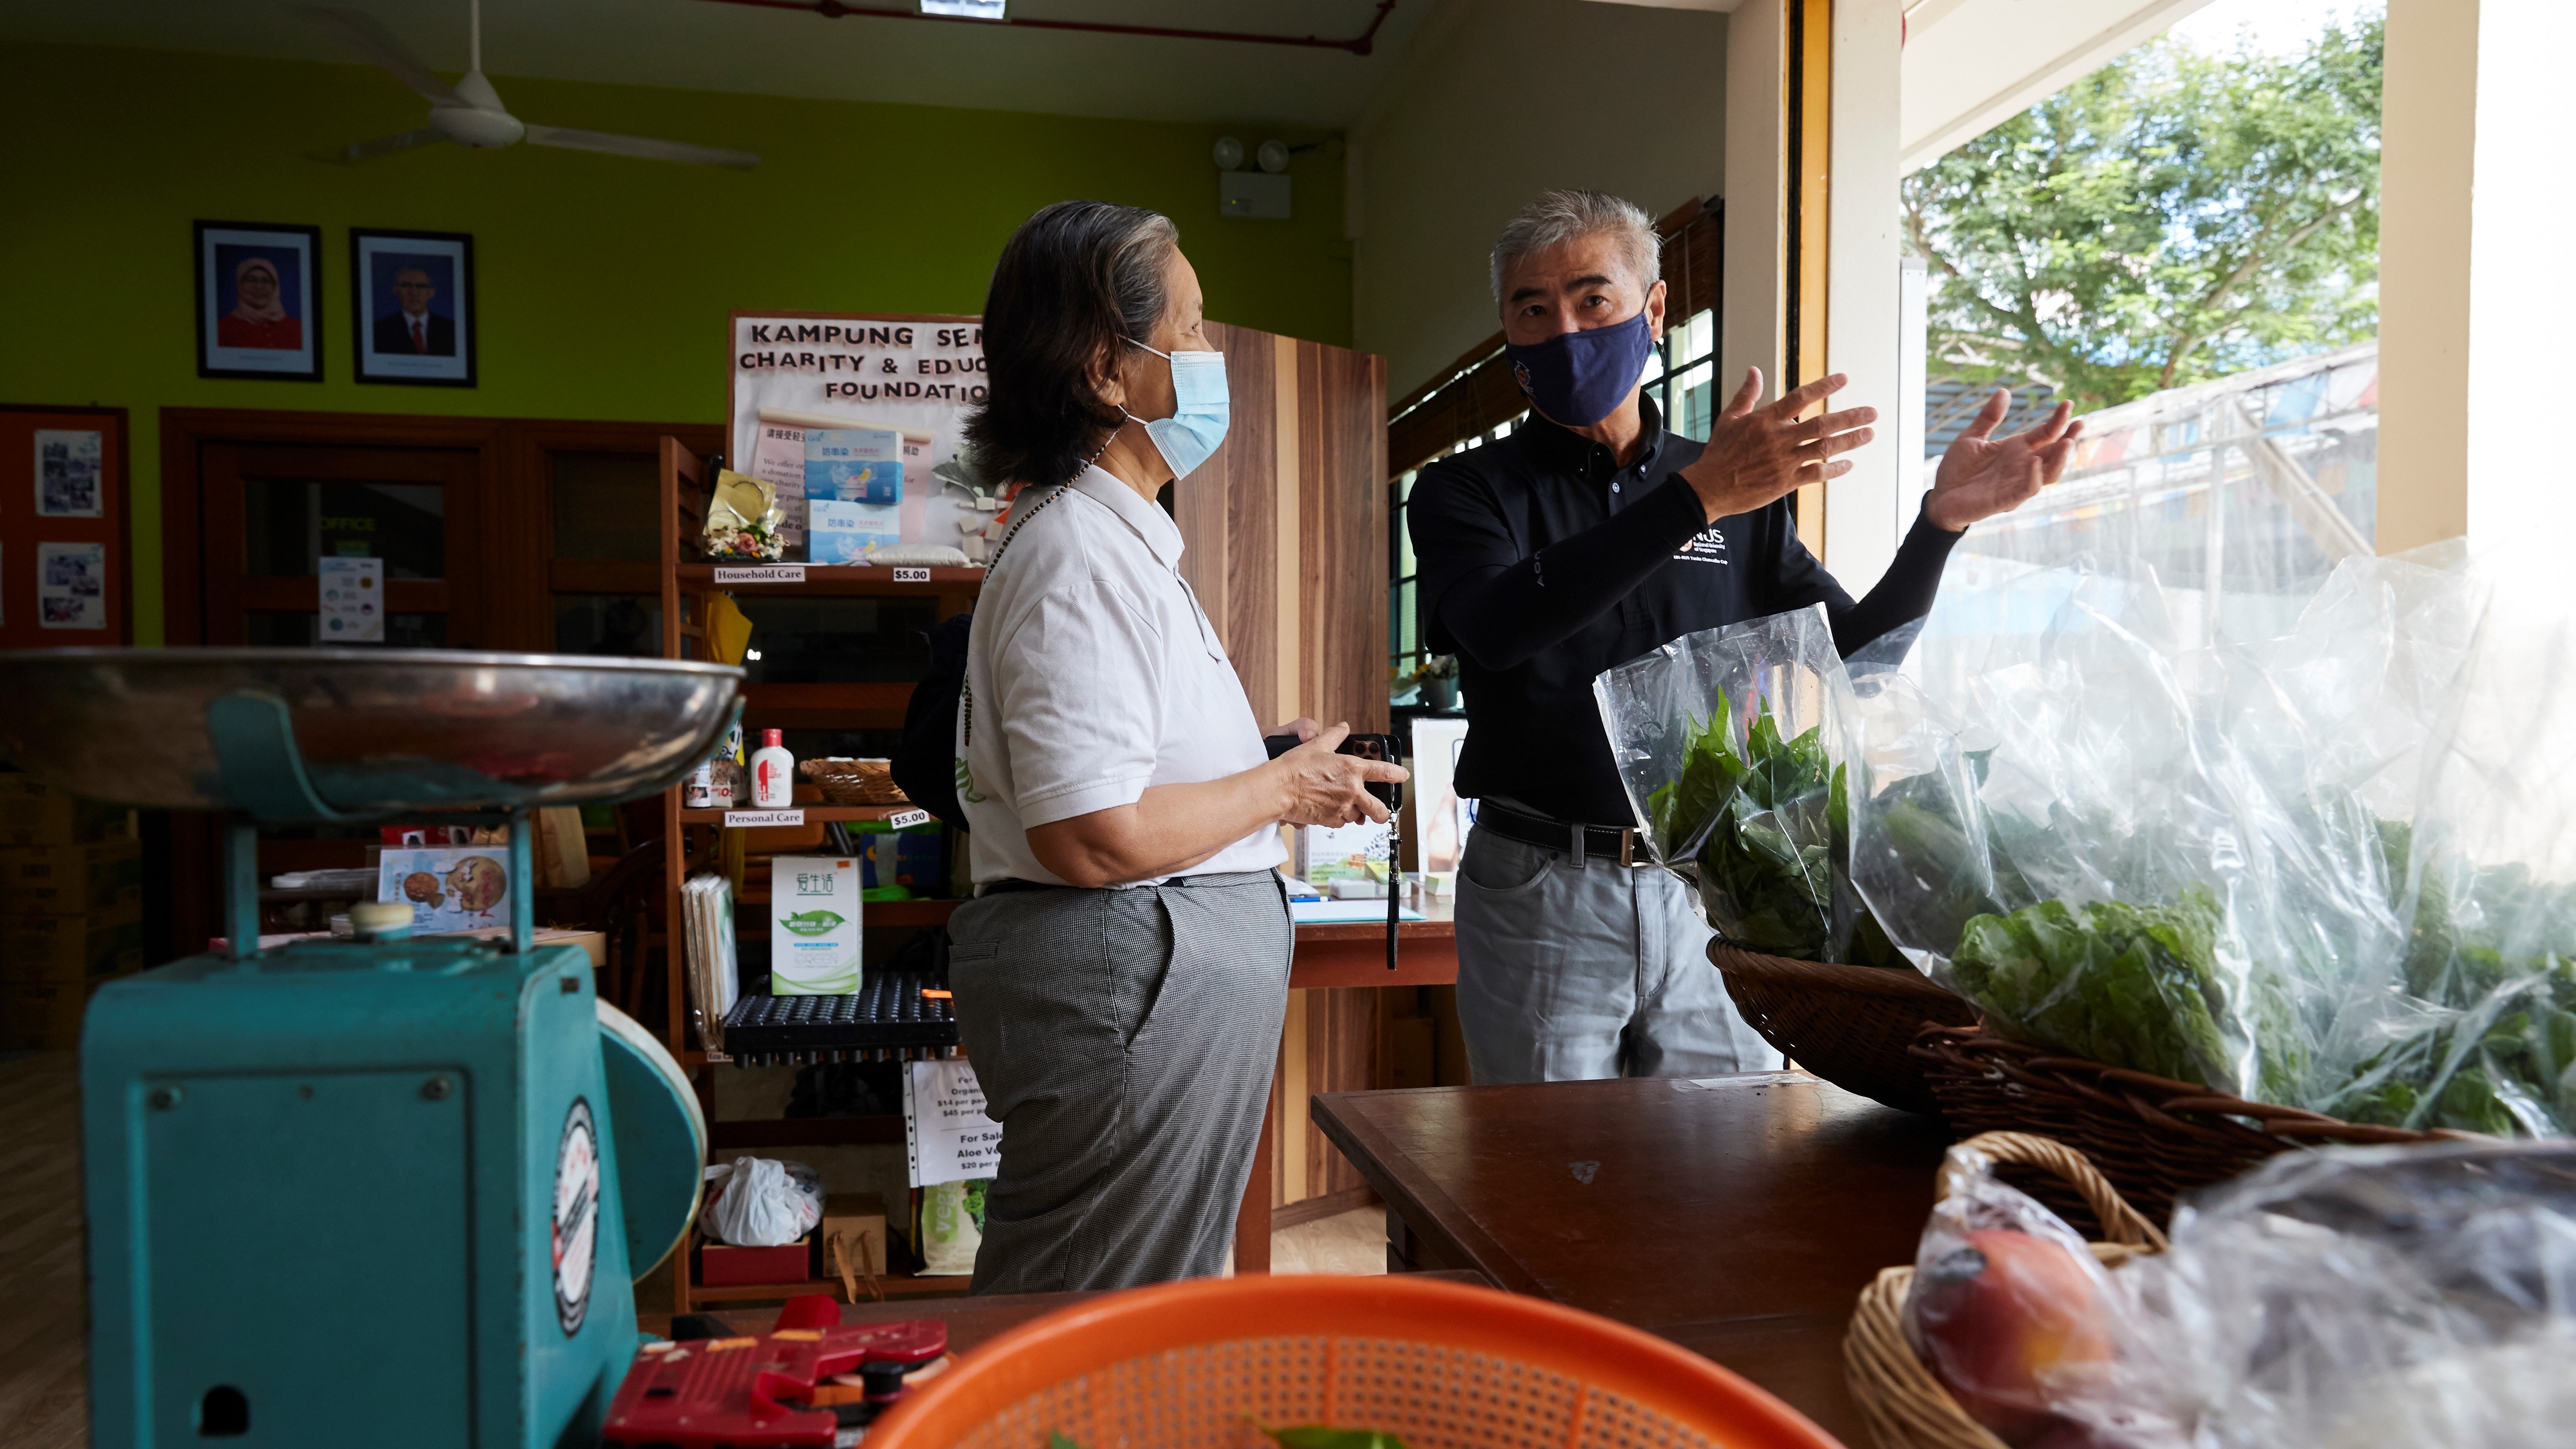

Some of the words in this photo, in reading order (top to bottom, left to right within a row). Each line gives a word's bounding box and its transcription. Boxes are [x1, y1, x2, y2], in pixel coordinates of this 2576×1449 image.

[751, 325, 914, 345] KAMPUNG
[740, 351, 864, 372] CHARITY
[882, 358, 898, 374] &
[320, 517, 376, 531] OFFICE
[718, 569, 774, 579] Household
[778, 569, 801, 579] Care
[895, 569, 927, 579] $5.00
[729, 814, 774, 823] Personal
[777, 813, 800, 822] Care
[894, 812, 925, 826] $5.00
[797, 873, 833, 892] 爱生活
[960, 1135, 978, 1143] For
[957, 1149, 981, 1158] Aloe
